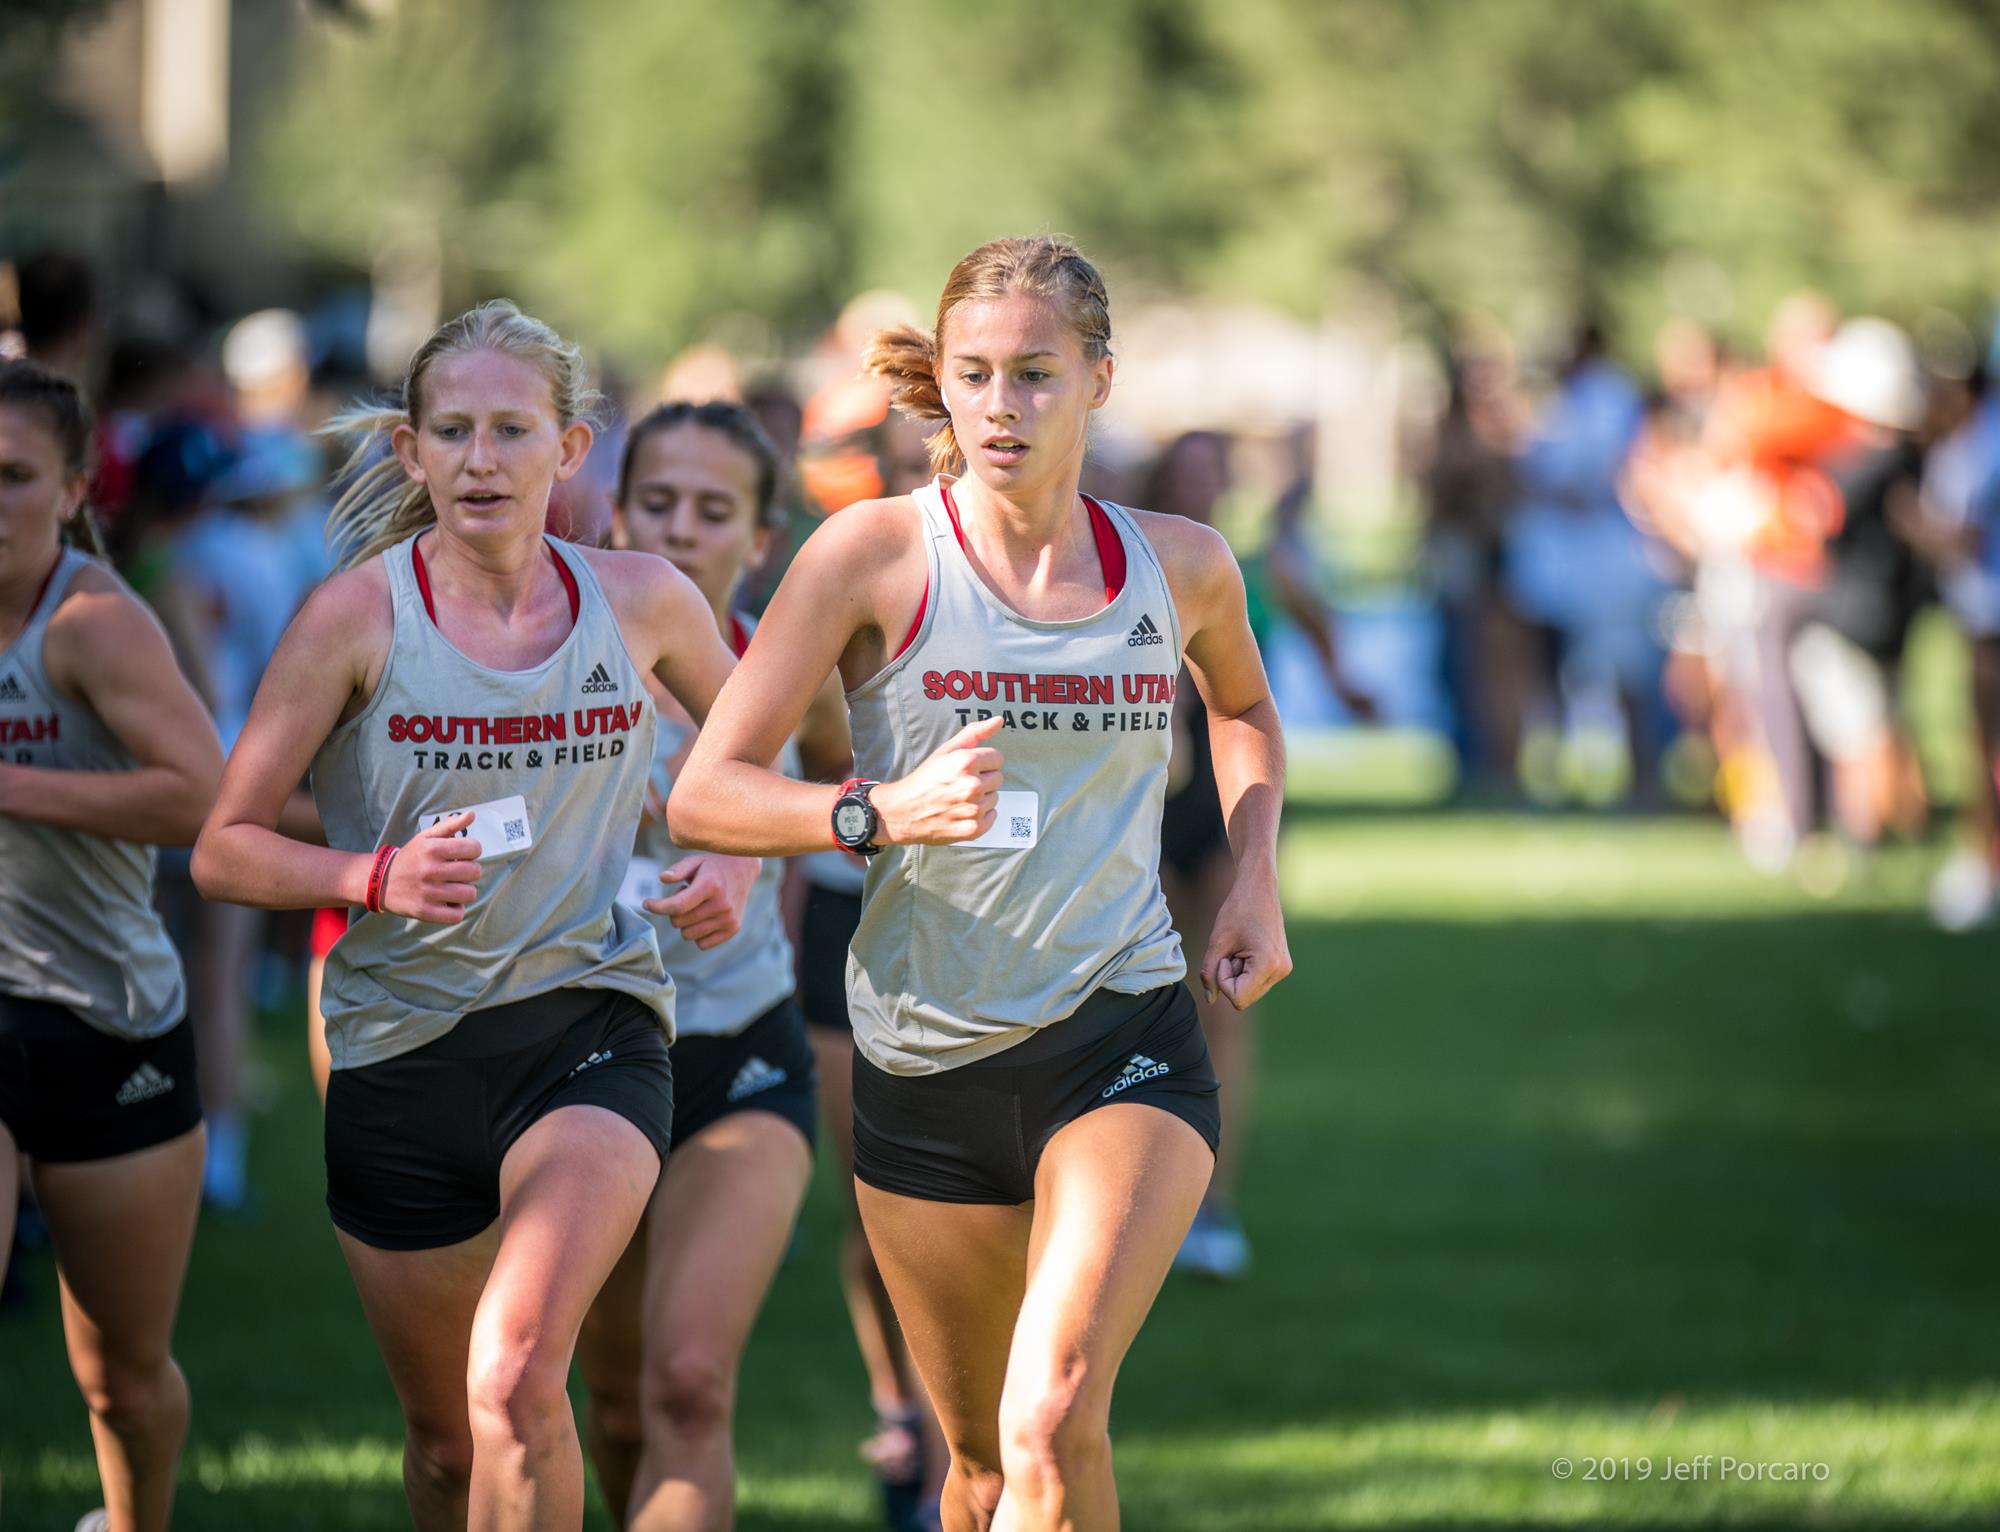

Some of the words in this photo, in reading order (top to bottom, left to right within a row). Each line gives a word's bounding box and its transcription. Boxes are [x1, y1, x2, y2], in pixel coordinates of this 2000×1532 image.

[1127, 633, 1164, 647] adidas
[581, 681, 618, 694] adidas
[922, 670, 1115, 705] SOUTHERN
[0, 714, 60, 743] TAH
[388, 713, 567, 745] SOUTHERN
[573, 700, 642, 738] UTAH
[1072, 712, 1090, 732] &
[1102, 711, 1168, 732] FIELD
[413, 751, 513, 770] TRACK
[526, 750, 543, 768] &
[554, 739, 625, 765] FIELD
[1102, 1062, 1170, 1098] adidas
